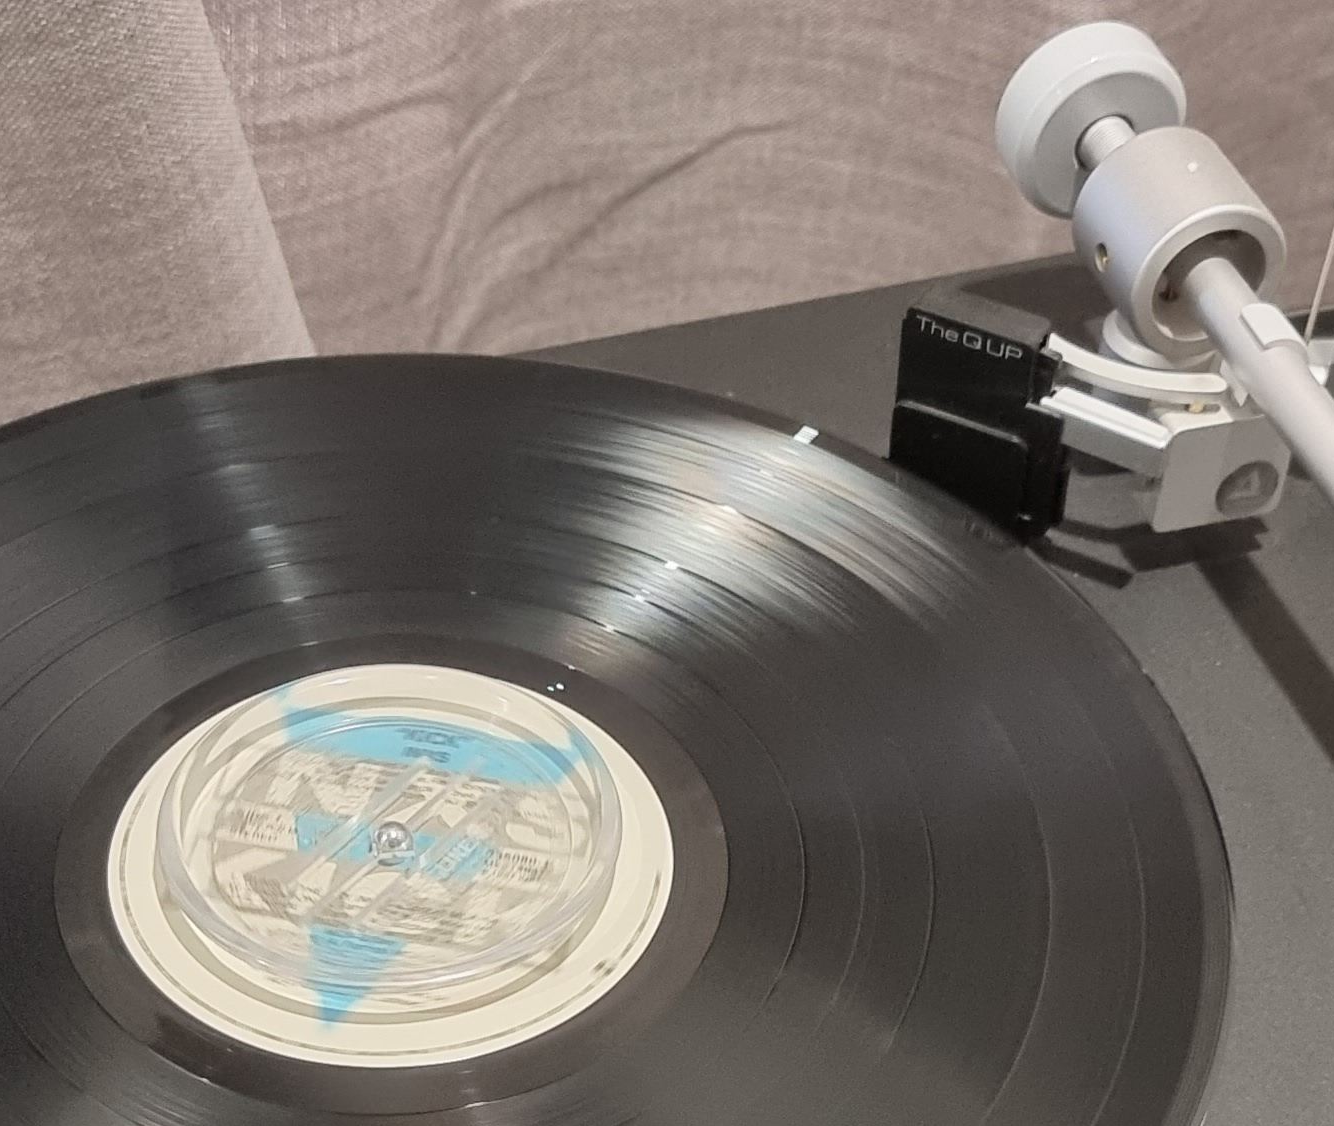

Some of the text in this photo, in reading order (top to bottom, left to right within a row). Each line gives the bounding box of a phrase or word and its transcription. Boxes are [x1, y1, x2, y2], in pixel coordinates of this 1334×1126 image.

[916, 314, 1023, 359] The Q UP
